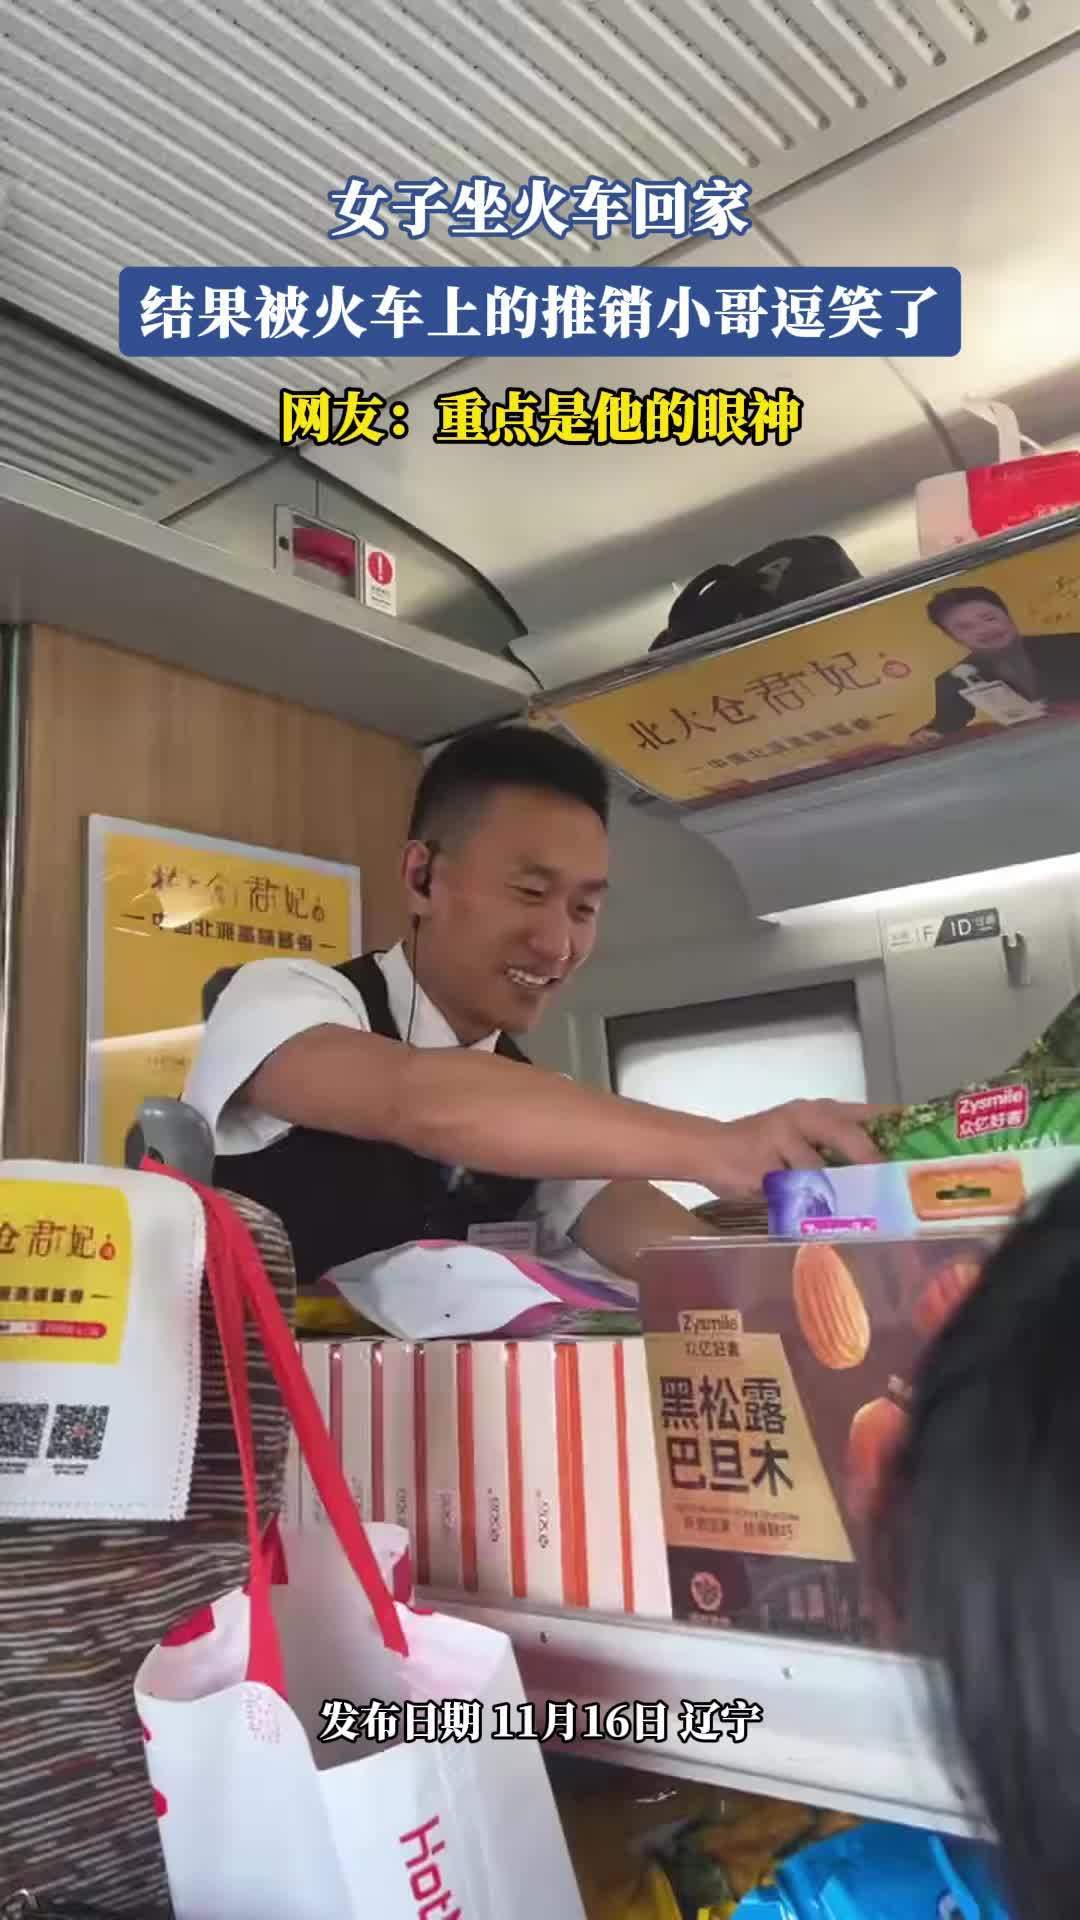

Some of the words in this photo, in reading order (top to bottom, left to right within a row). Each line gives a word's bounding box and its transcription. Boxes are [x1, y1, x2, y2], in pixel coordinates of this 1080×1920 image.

[659, 1375, 787, 1435] 黑松露
[666, 1436, 795, 1497] 巴旦木
